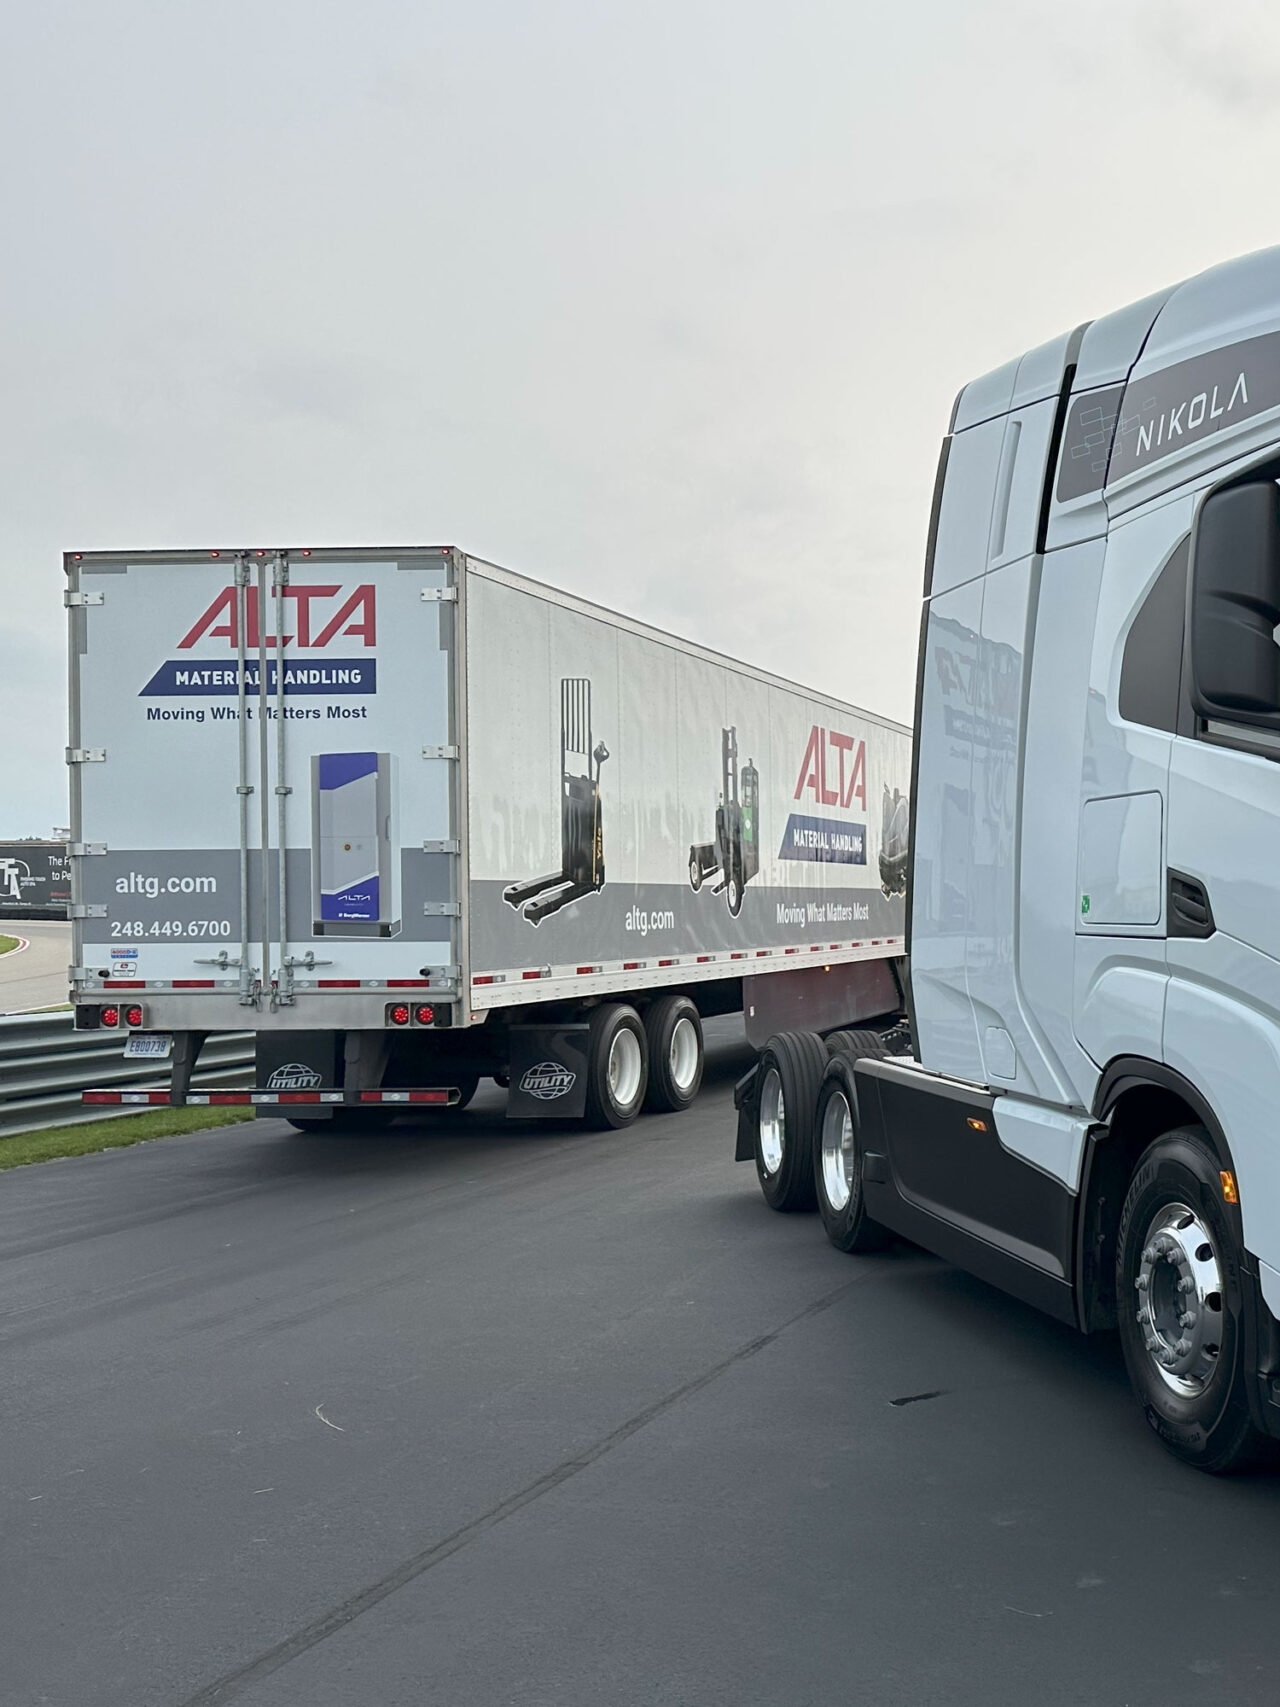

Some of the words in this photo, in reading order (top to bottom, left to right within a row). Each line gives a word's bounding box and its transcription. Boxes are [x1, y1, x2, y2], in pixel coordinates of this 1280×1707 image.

[1136, 372, 1248, 457] NIKOLA
[176, 584, 377, 649] ALTA
[147, 707, 205, 722] Moving
[327, 705, 367, 719] Most
[793, 724, 867, 812] ALTA
[793, 828, 829, 850] MATERIAL
[831, 832, 863, 853] HANDLING
[48, 856, 62, 866] The
[52, 871, 60, 880] to
[115, 872, 217, 898] altg.com
[625, 904, 675, 936] altg.com
[776, 902, 806, 928] Moving
[807, 902, 825, 922] What
[827, 902, 853, 921] Matters
[853, 902, 869, 920] Most
[111, 920, 231, 937] 248.449.6700
[270, 1076, 319, 1088] UTILITY
[523, 1075, 573, 1089] UTILITY
